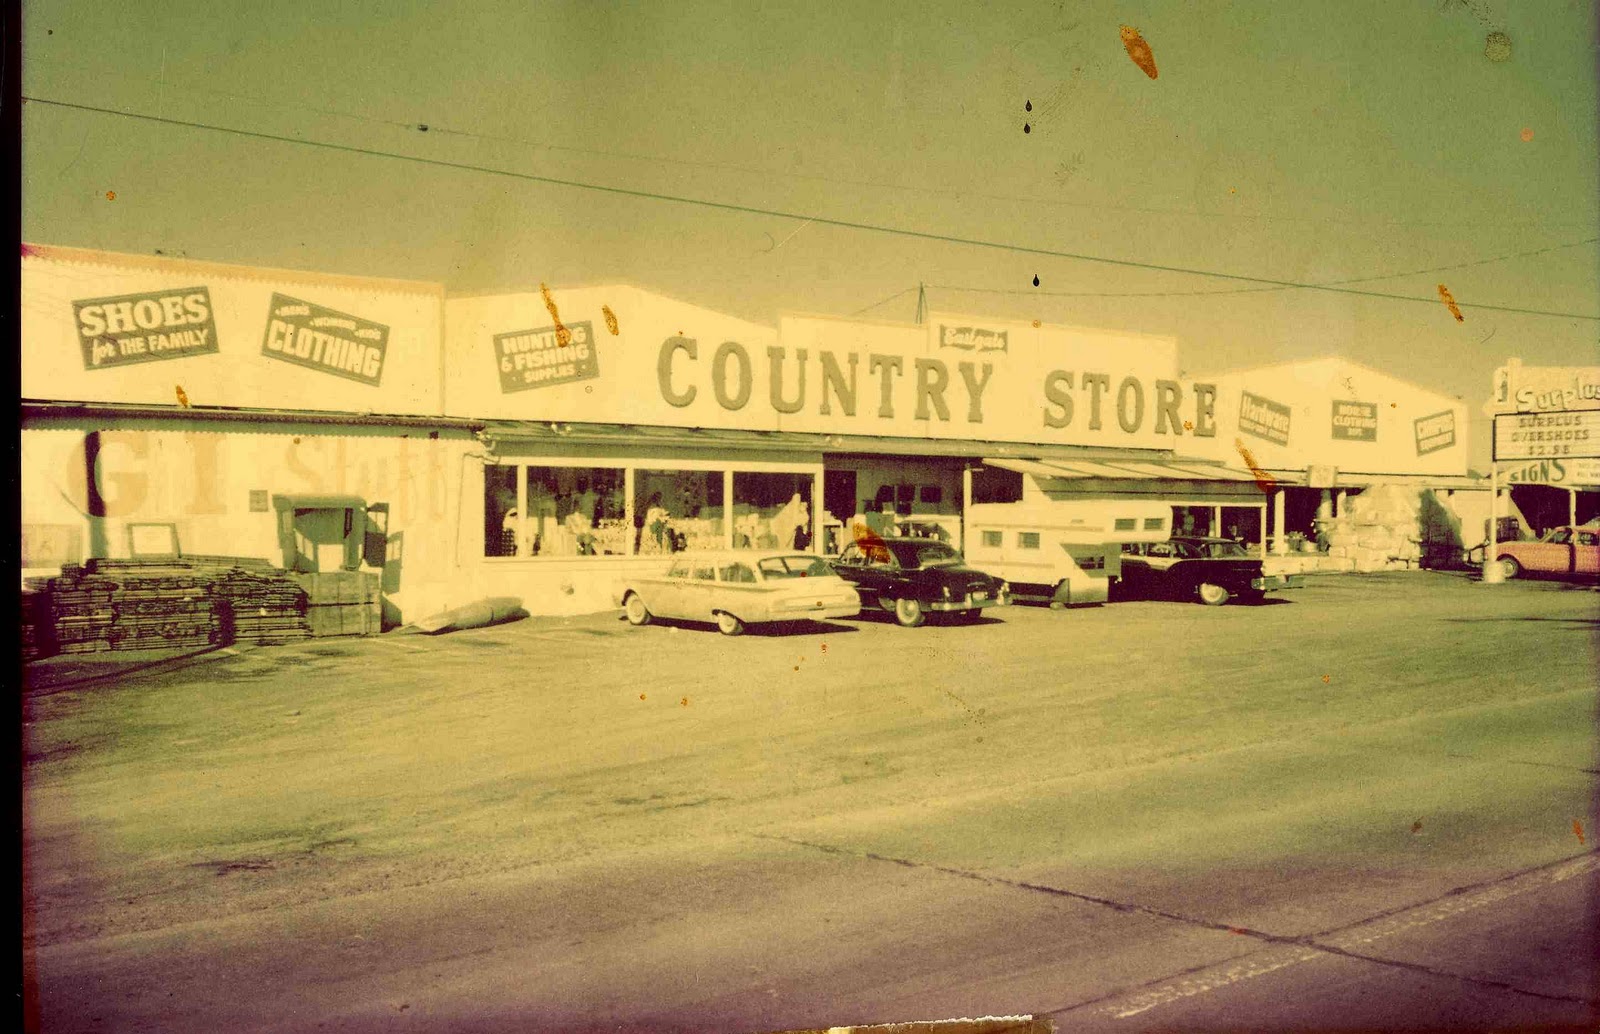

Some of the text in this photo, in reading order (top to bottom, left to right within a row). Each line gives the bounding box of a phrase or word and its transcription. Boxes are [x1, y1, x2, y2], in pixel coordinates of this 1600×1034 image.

[80, 294, 208, 336] SHOES
[92, 329, 208, 365] for THE FAMILY
[267, 319, 381, 378] CLOTHING
[514, 343, 589, 370] FISHING
[657, 335, 1217, 438] COUNTRY STORE
[1511, 430, 1590, 443] OVERSHOES
[1518, 415, 1582, 428] SURPLUS
